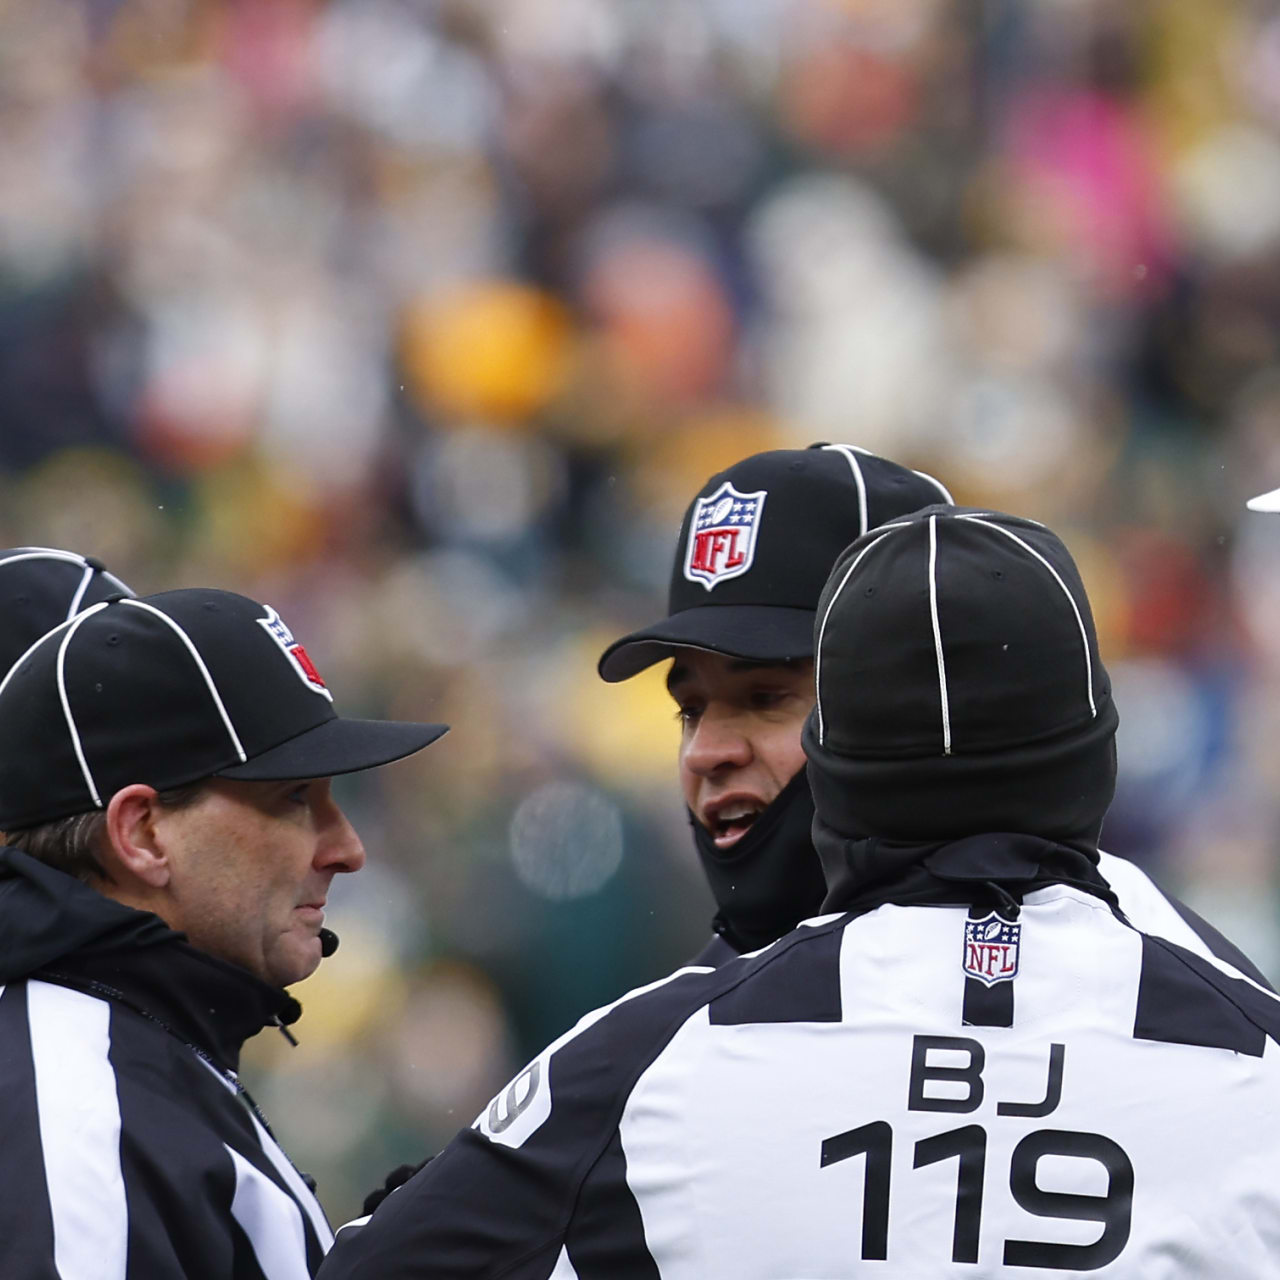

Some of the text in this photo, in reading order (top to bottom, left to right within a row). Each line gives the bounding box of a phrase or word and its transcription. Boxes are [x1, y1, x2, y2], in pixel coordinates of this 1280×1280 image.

[691, 528, 745, 575] NFL
[967, 944, 1014, 977] NFL
[908, 1034, 1065, 1118] BJ
[820, 1120, 1135, 1271] 119
